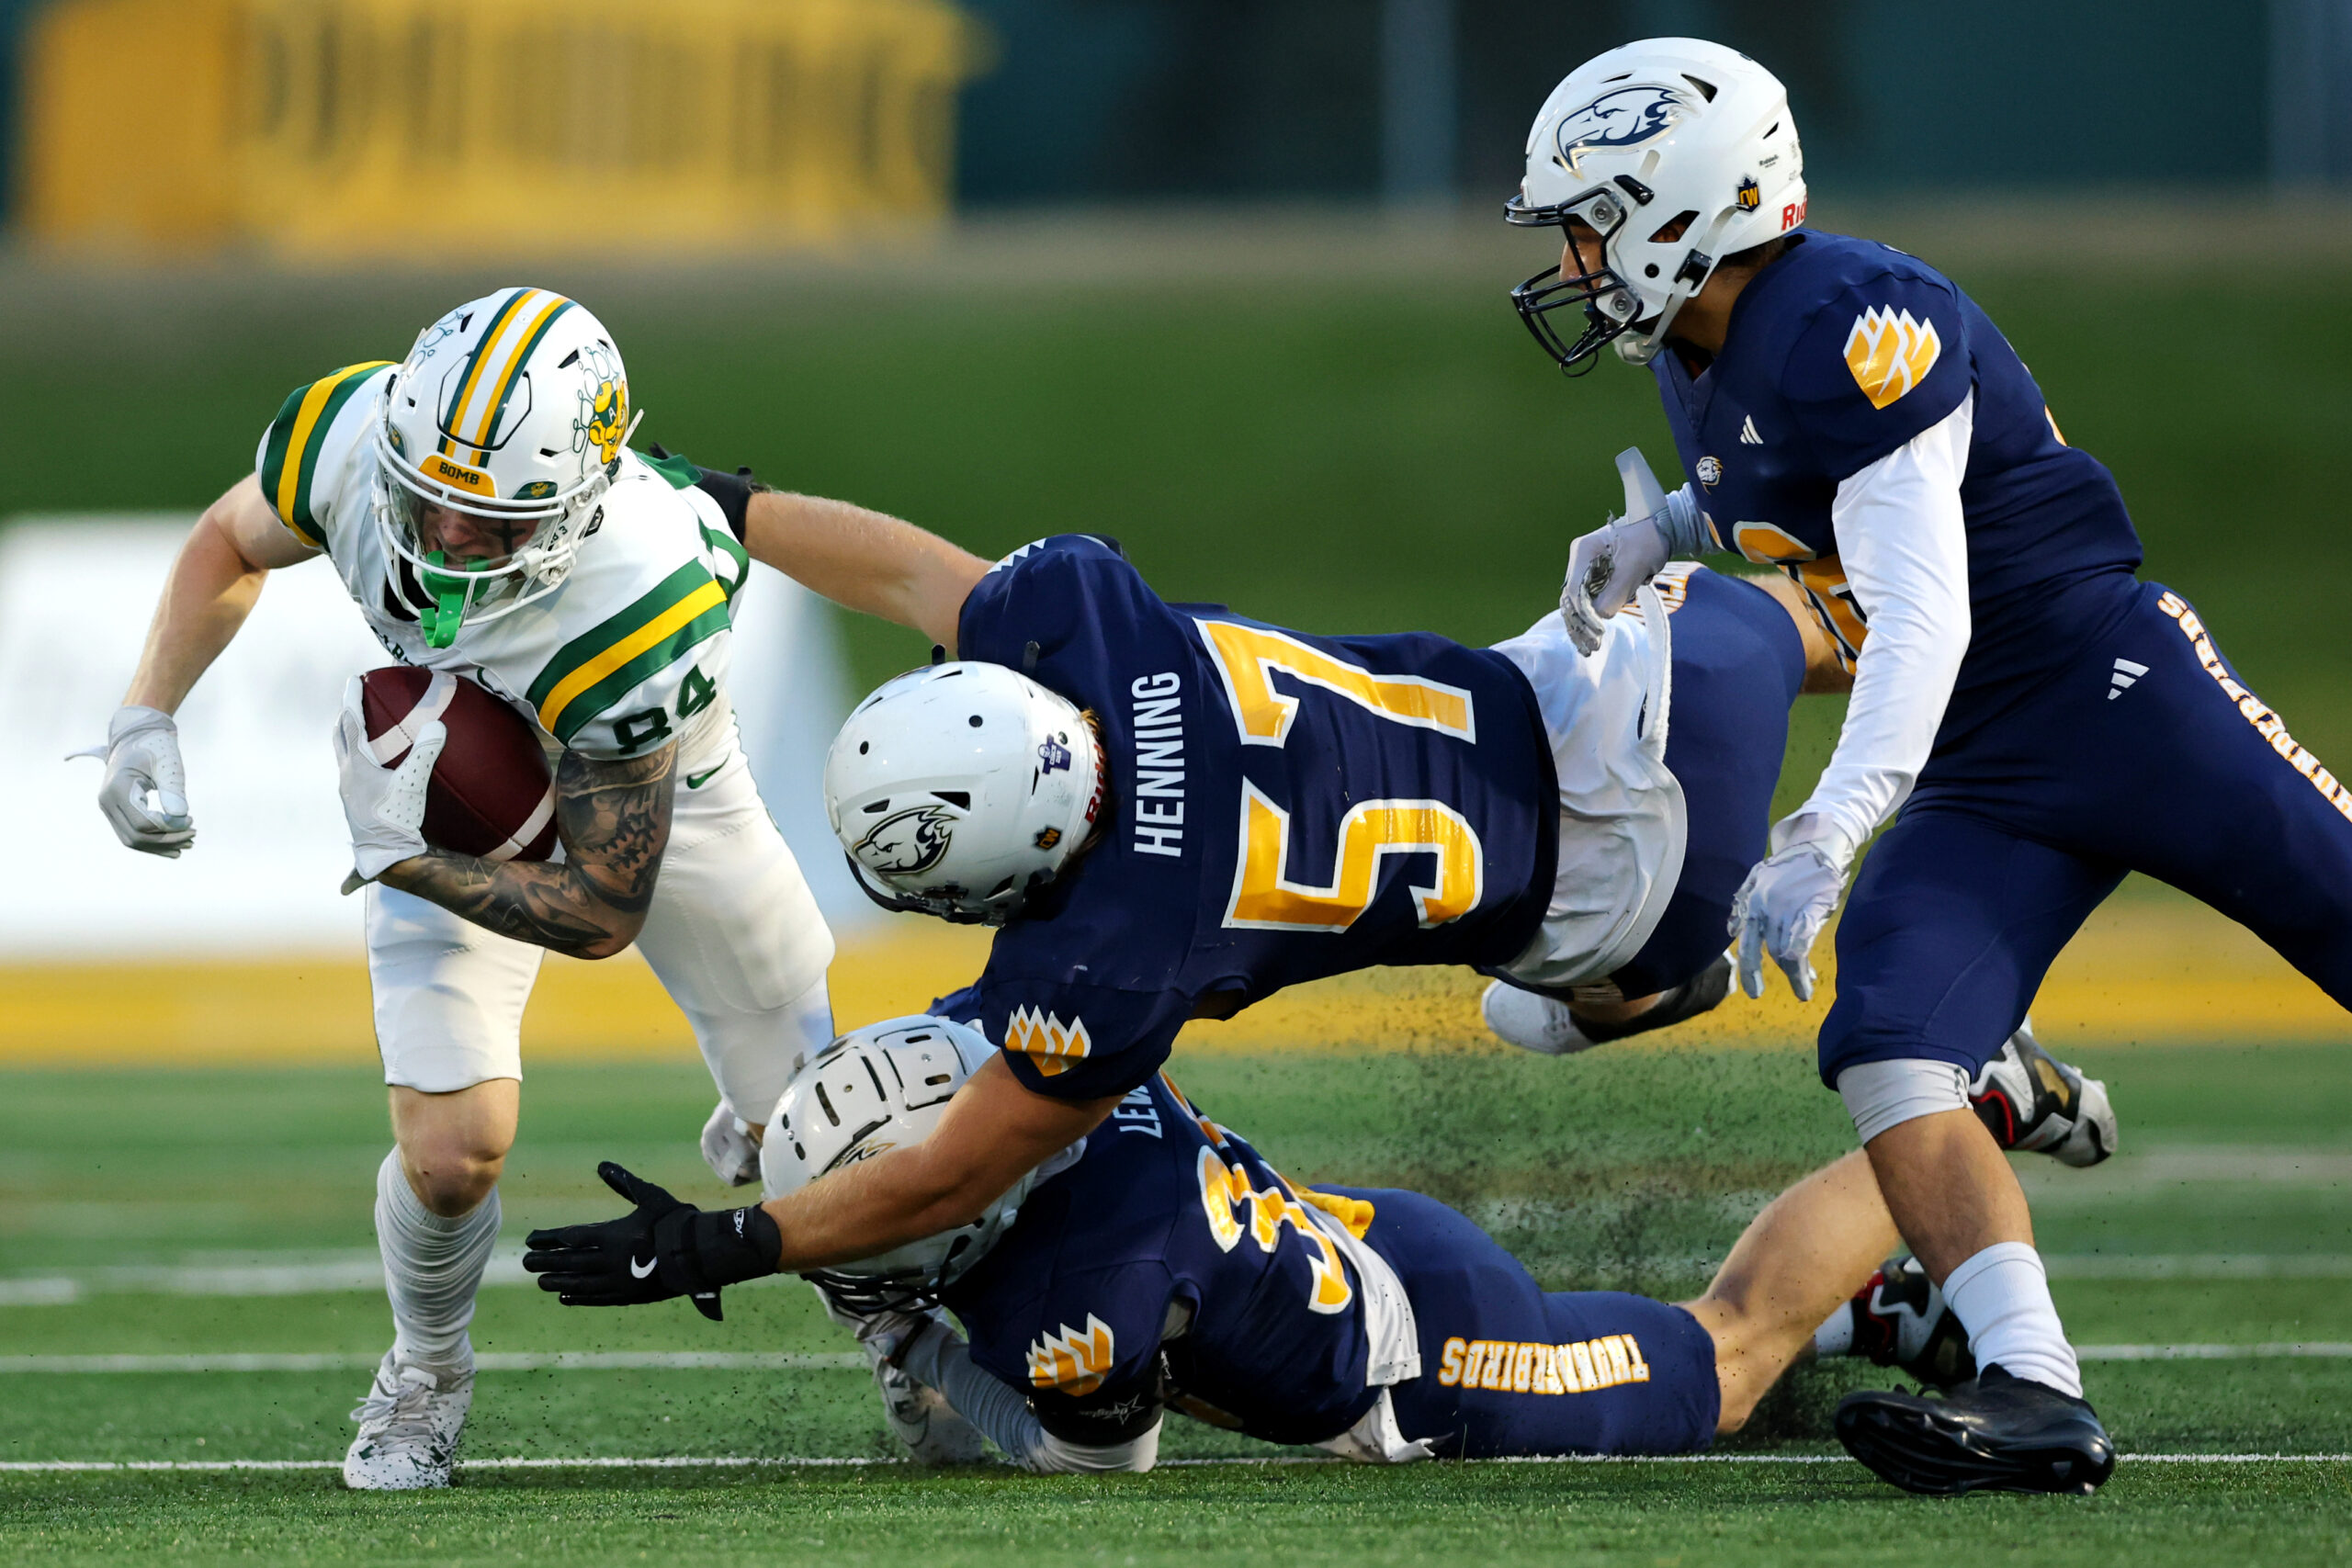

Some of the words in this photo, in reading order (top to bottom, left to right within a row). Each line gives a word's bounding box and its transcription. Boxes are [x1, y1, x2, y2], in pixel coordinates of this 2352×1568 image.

[438, 461, 480, 486] BOMB
[613, 663, 718, 756] 84
[1131, 671, 1186, 858] HENNING
[1193, 617, 1483, 934] 57
[1438, 1333, 1651, 1396] THUNDERBIRDS
